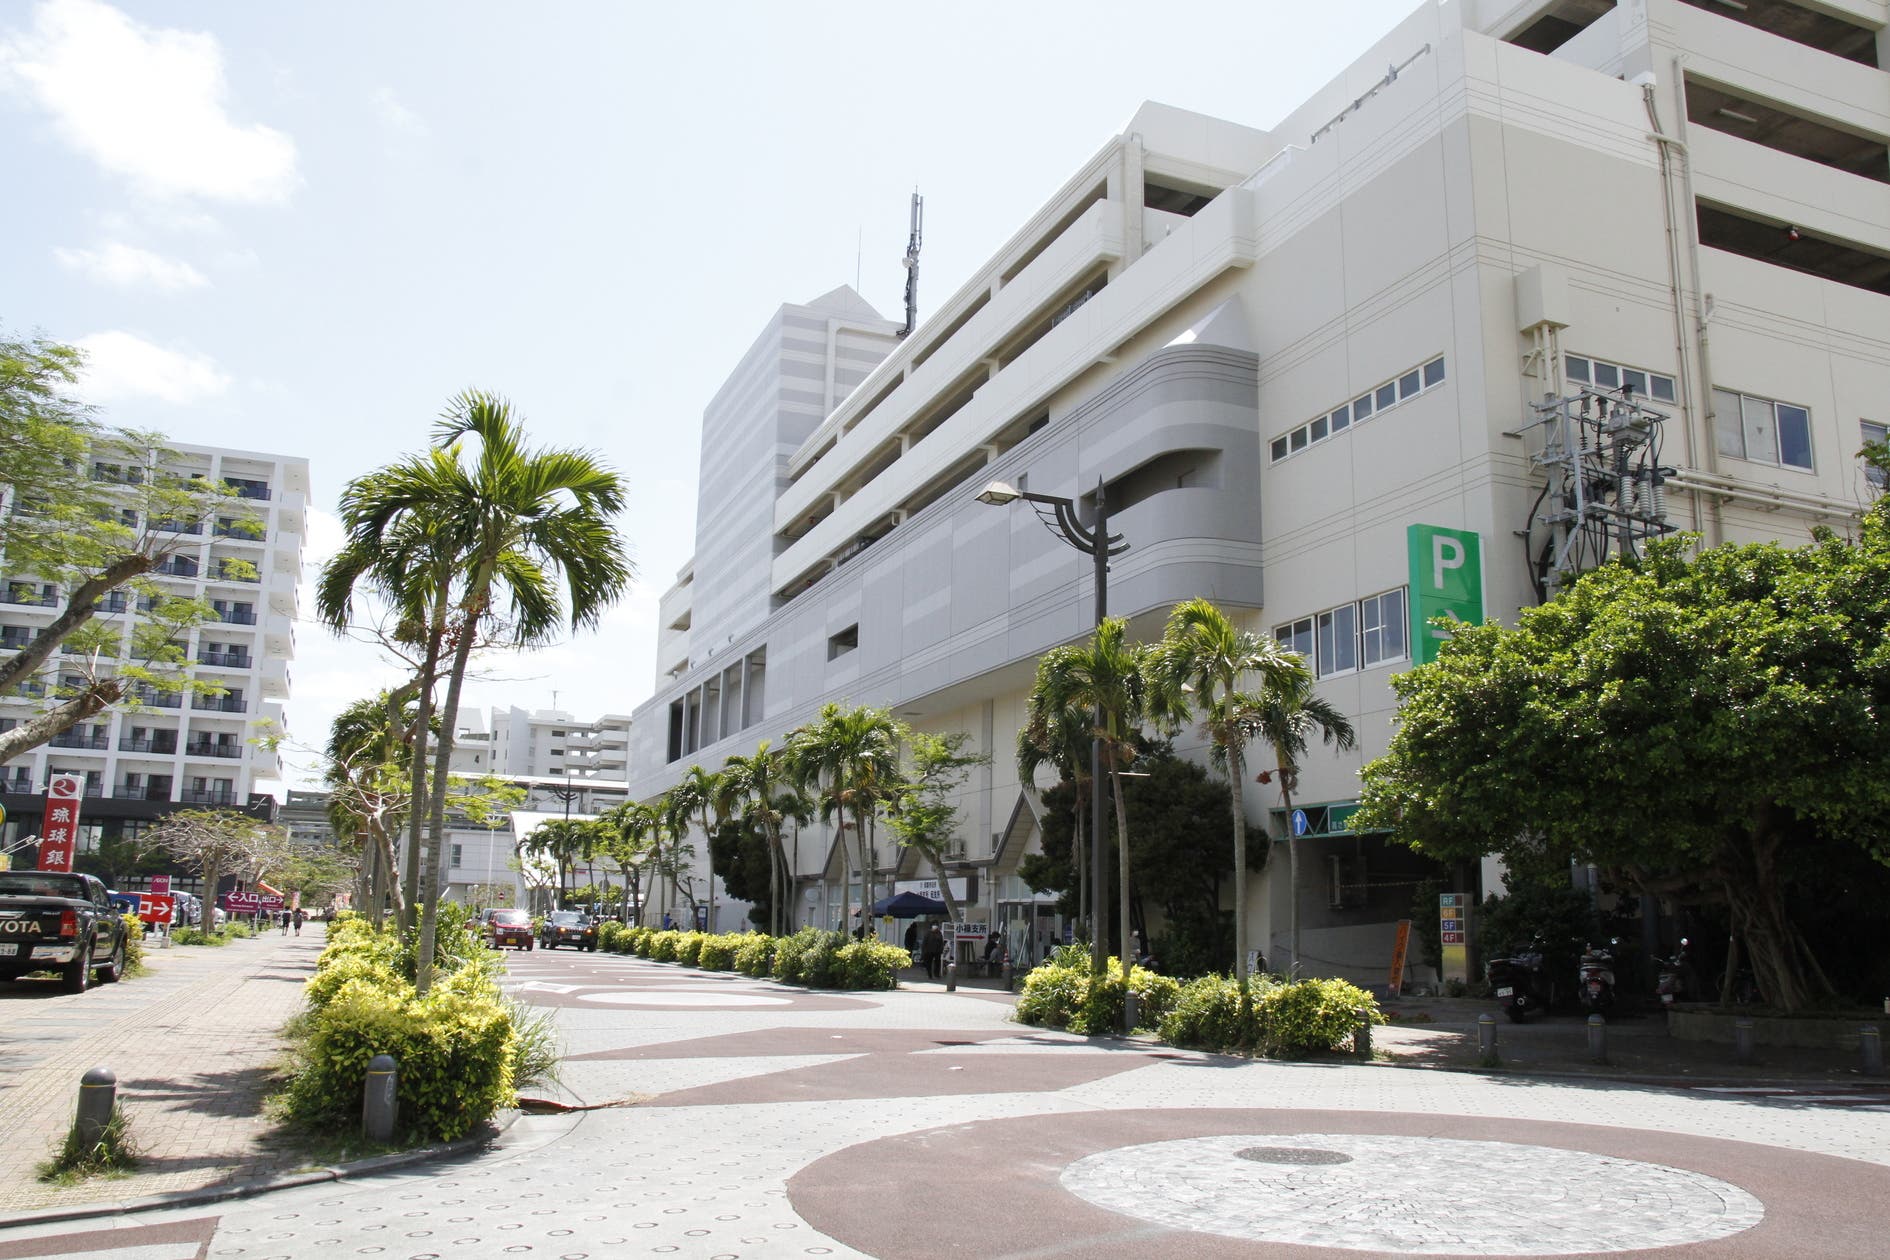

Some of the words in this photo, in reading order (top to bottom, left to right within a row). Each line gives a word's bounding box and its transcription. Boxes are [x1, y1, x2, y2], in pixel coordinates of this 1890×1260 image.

[1432, 534, 1466, 590] P
[46, 807, 70, 871] 琉球銀
[239, 893, 259, 903] 入口
[1443, 897, 1454, 905] RF
[1444, 922, 1454, 930] 5F
[1444, 934, 1455, 942] 4F
